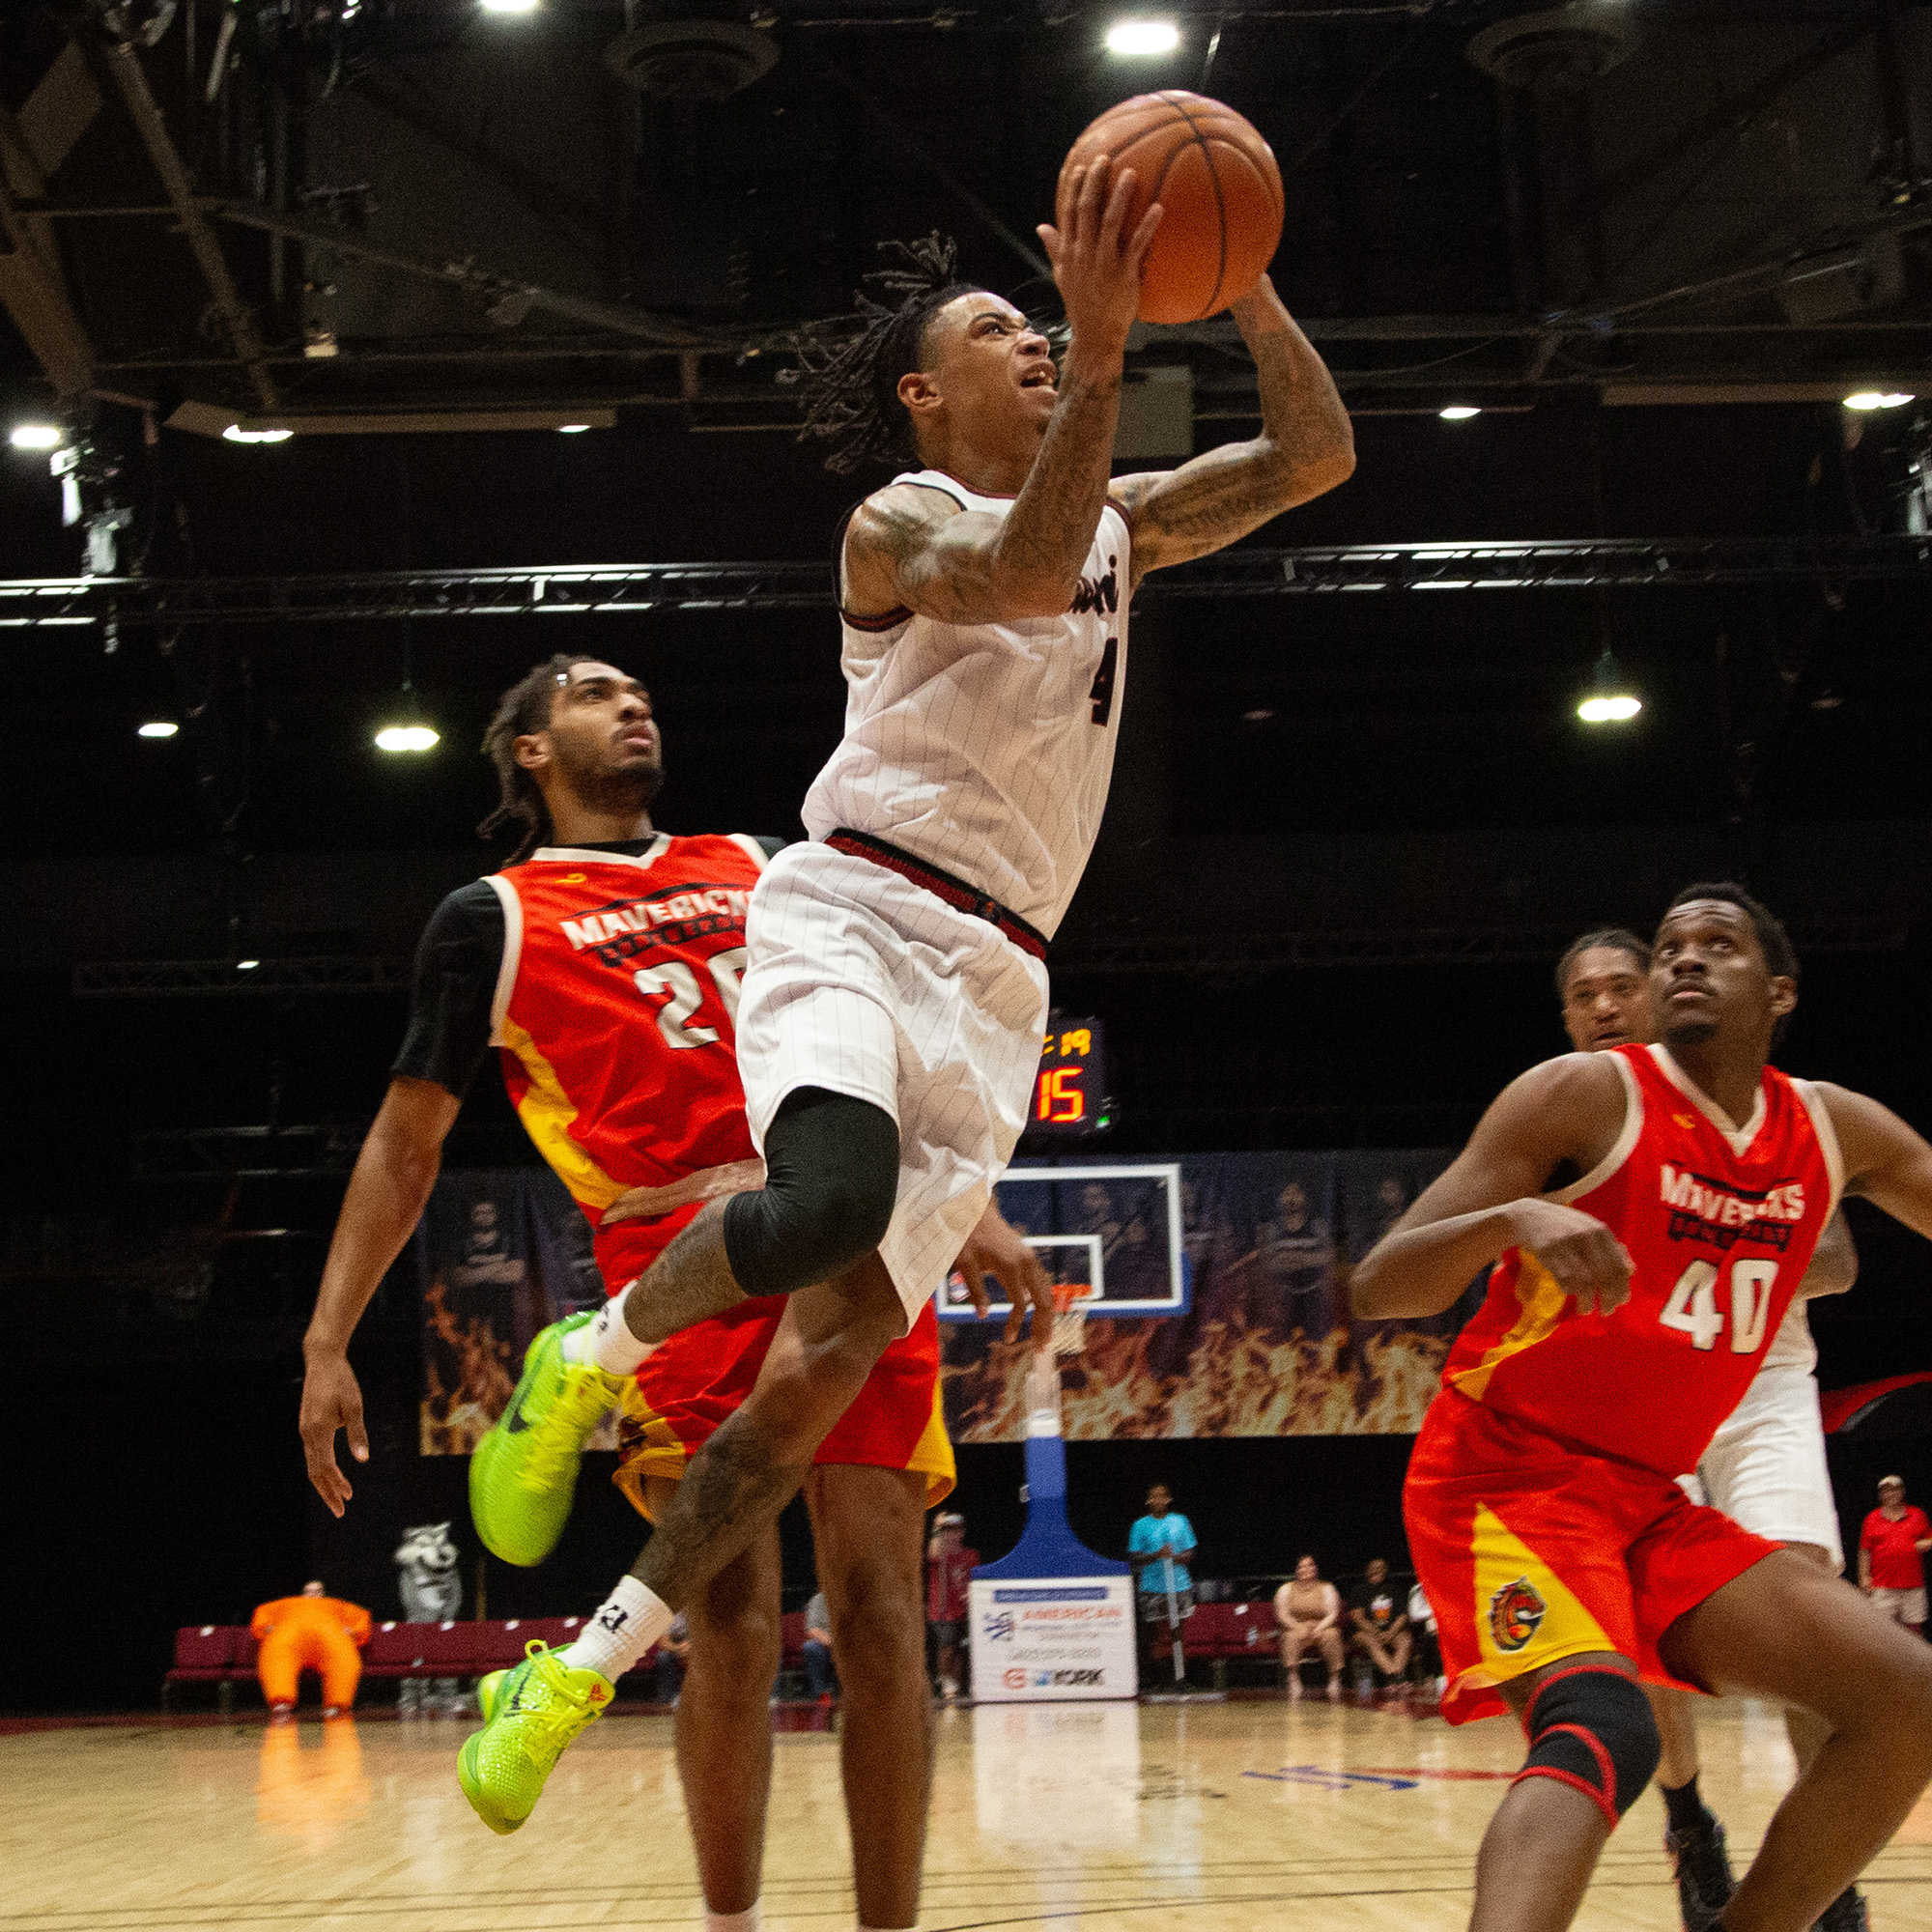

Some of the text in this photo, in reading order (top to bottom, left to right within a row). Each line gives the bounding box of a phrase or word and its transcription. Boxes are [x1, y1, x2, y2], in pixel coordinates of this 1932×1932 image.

[1089, 637, 1118, 727] 4
[558, 889, 754, 951] MAVERICK
[1659, 1259, 1780, 1353] 40
